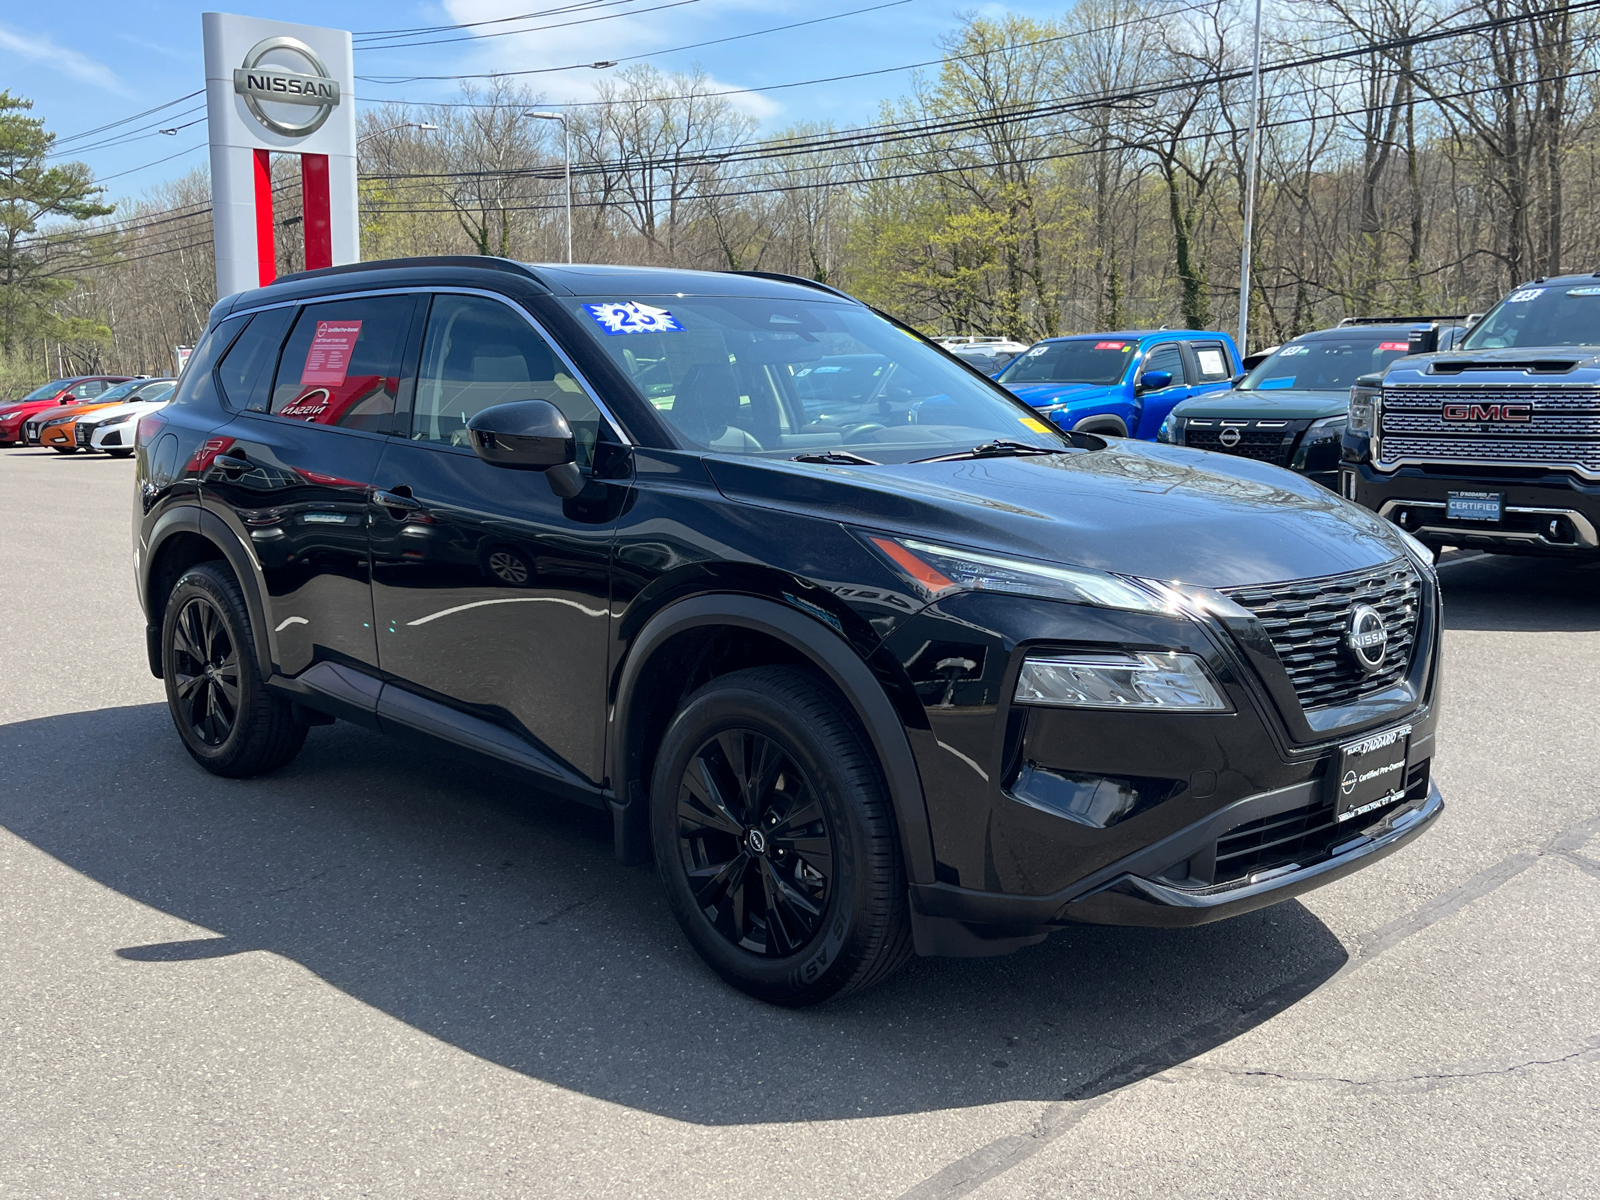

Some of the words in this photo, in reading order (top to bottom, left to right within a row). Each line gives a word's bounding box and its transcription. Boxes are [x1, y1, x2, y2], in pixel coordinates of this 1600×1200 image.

[247, 75, 332, 98] NISSAN
[1443, 404, 1530, 420] GMC
[1450, 501, 1499, 511] CERTIFIED
[1351, 627, 1388, 647] NISSAN
[1362, 732, 1397, 754] D'ADDARIO
[1359, 768, 1380, 783] Certified
[1380, 758, 1405, 775] Pre-Owned
